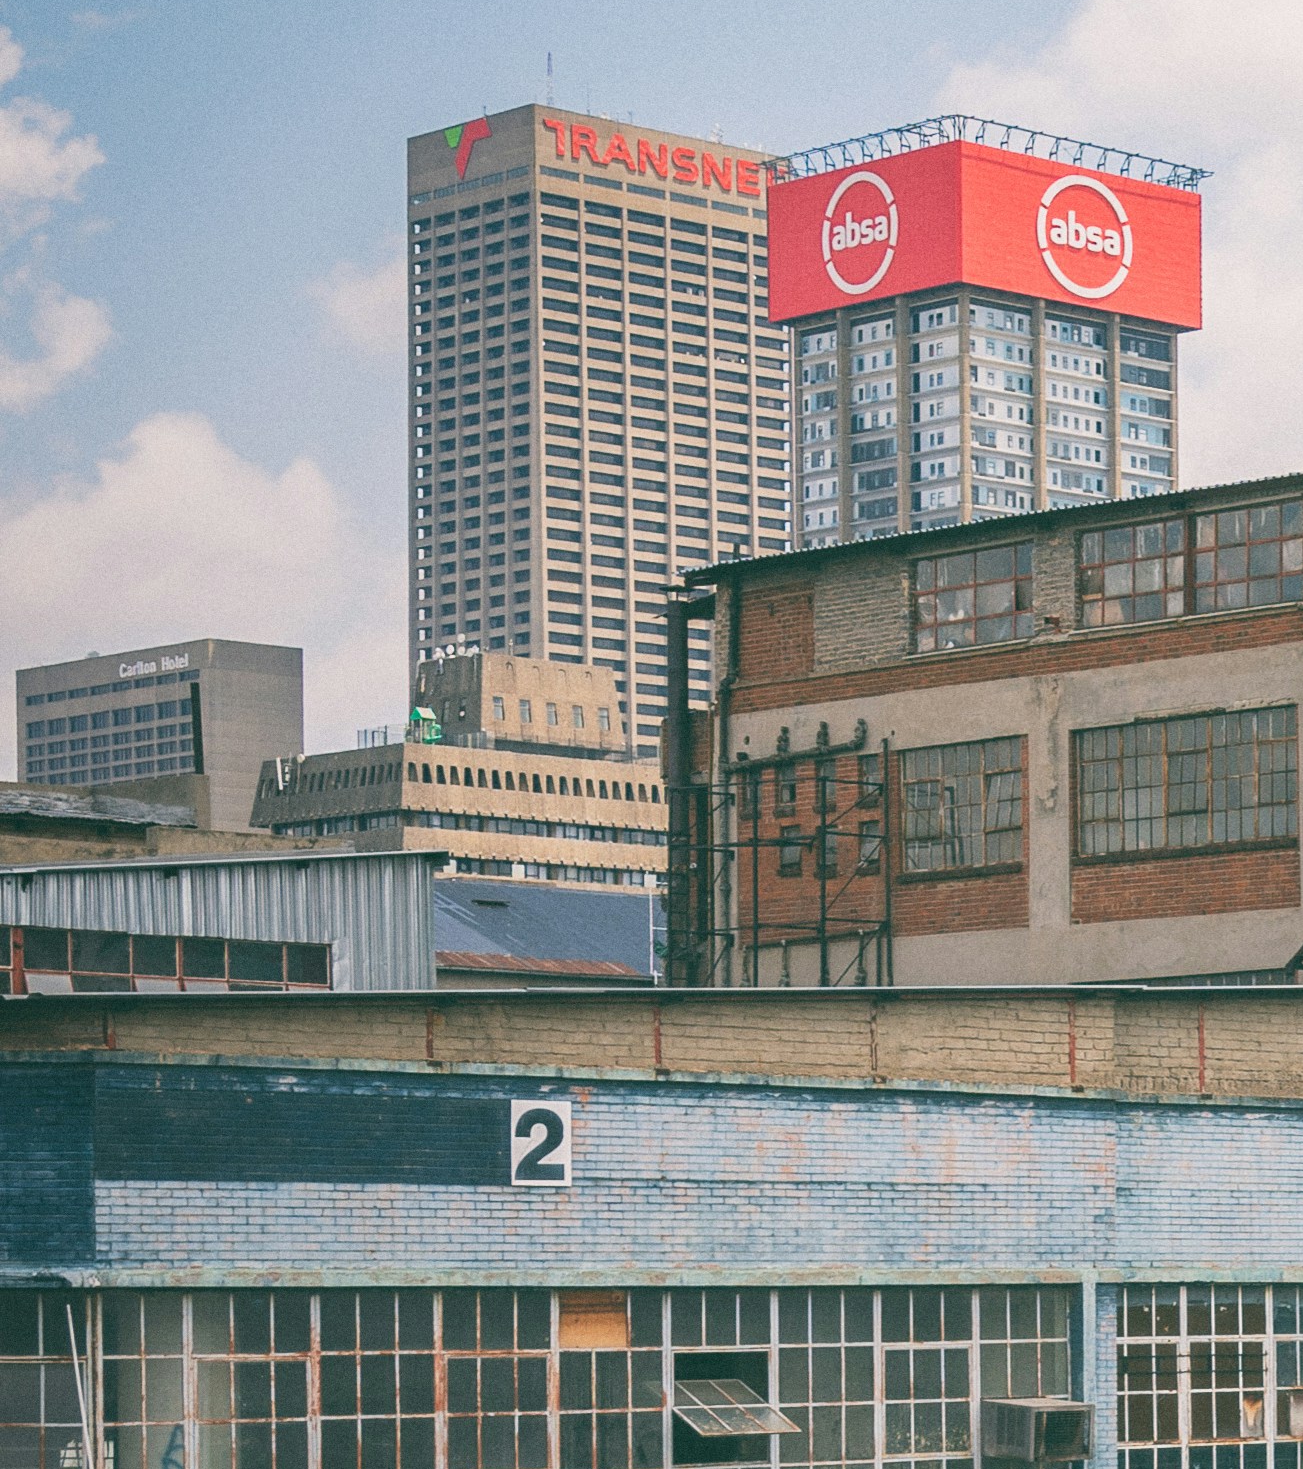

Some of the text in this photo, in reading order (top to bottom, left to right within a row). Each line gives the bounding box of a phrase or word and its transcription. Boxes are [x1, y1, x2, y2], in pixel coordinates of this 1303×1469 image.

[832, 211, 889, 251] absa
[1050, 210, 1121, 256] absa
[119, 653, 189, 678] Carlton Hotel
[515, 1108, 564, 1180] 2
